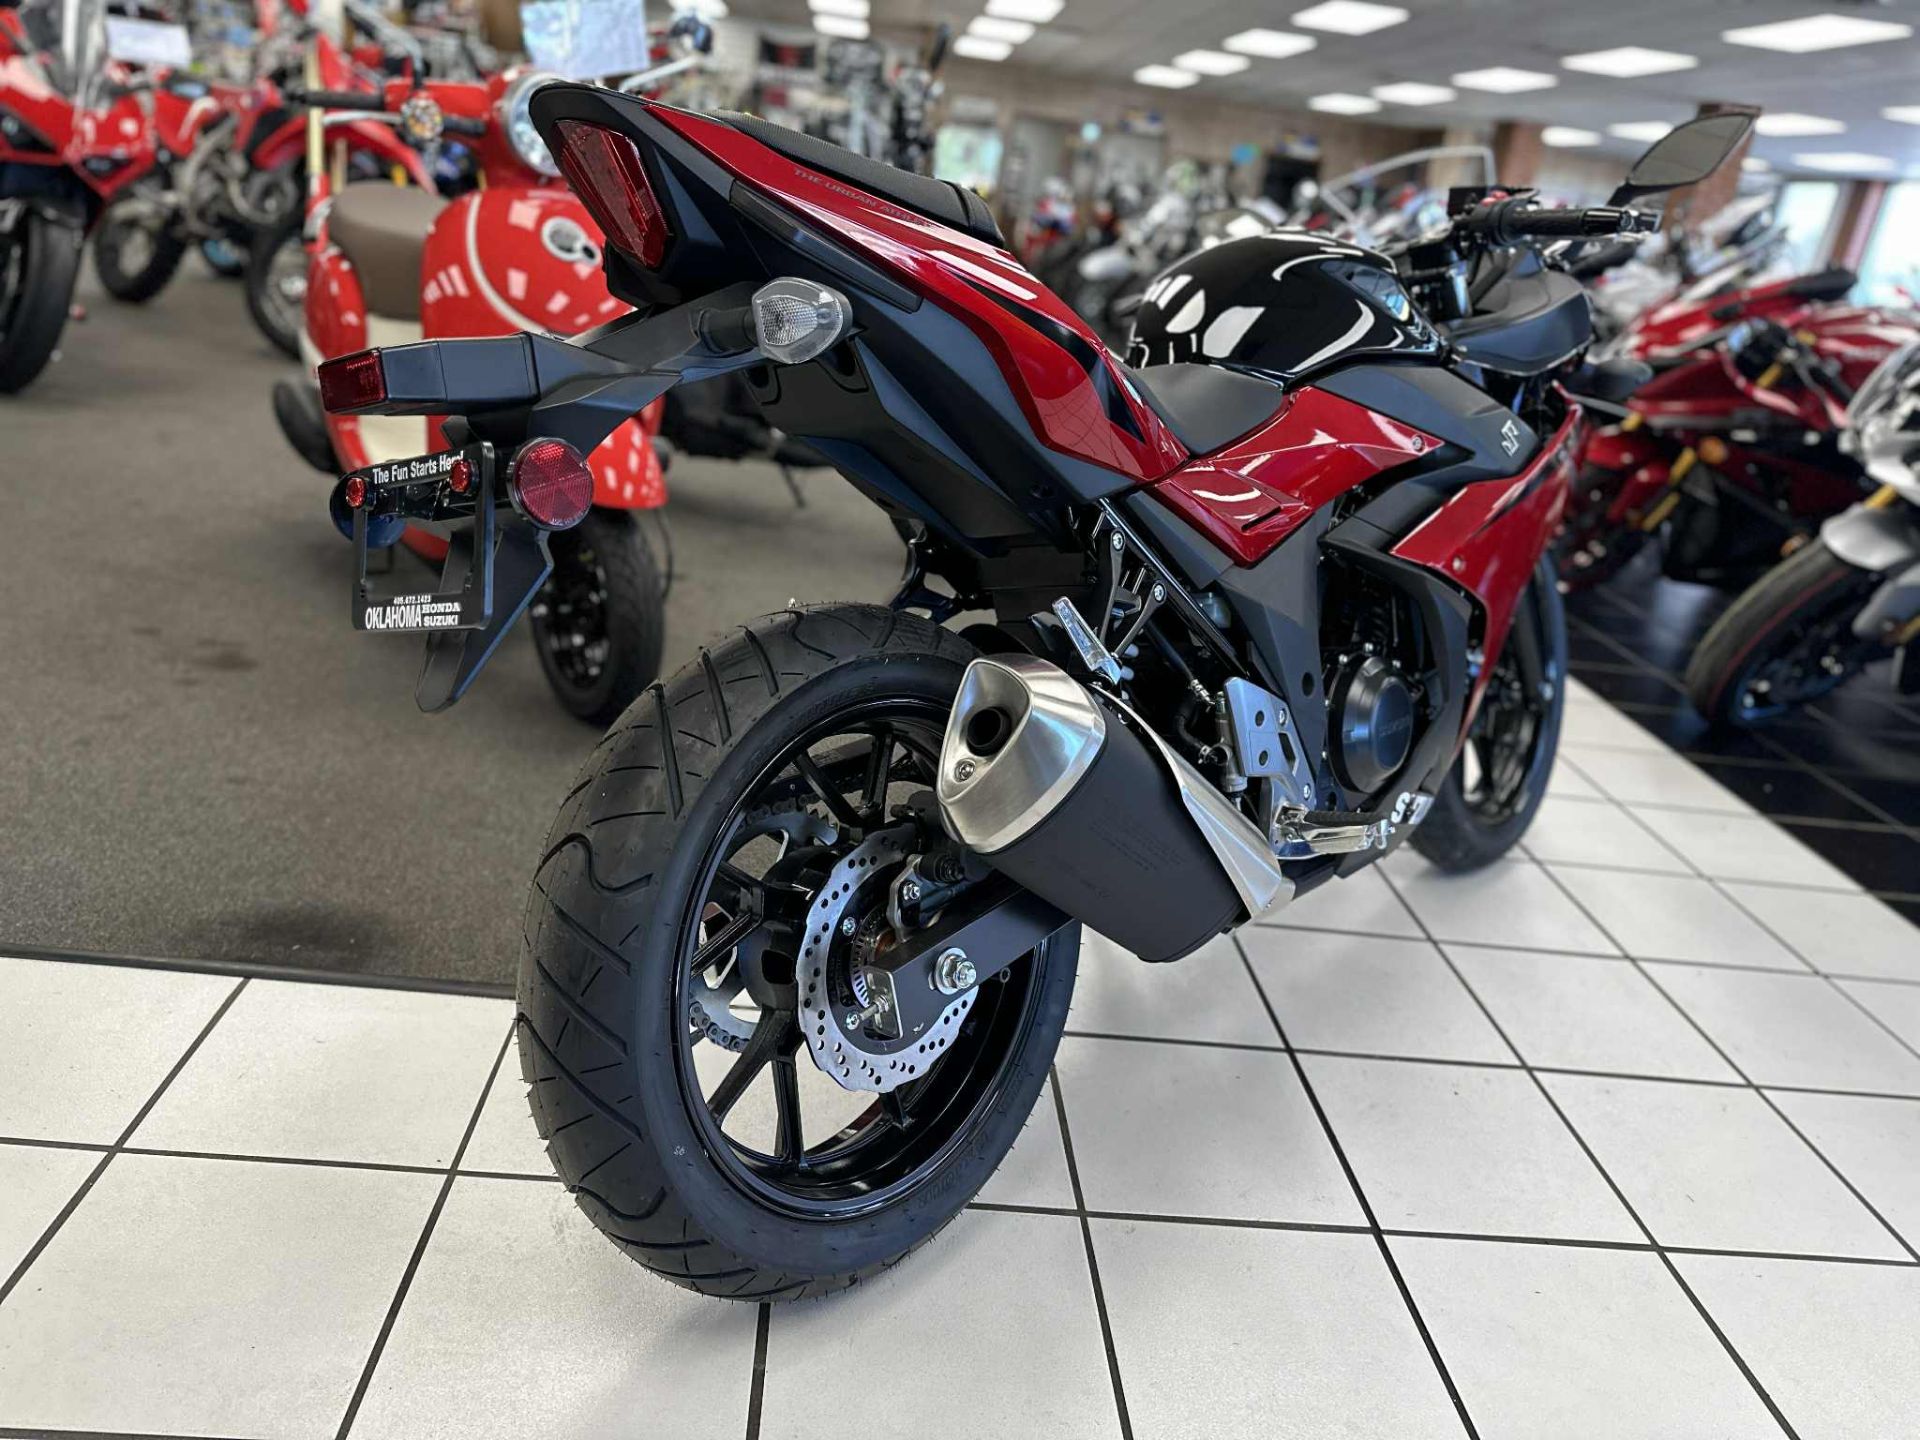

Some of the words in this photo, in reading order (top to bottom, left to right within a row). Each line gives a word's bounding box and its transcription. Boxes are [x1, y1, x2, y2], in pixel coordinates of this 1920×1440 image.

[372, 466, 389, 484] The
[391, 464, 409, 482] Fun
[410, 459, 437, 477] Starts
[422, 602, 460, 613] HONDA
[365, 605, 422, 629] OKLAHOMA
[423, 615, 459, 627] SUZUKI
